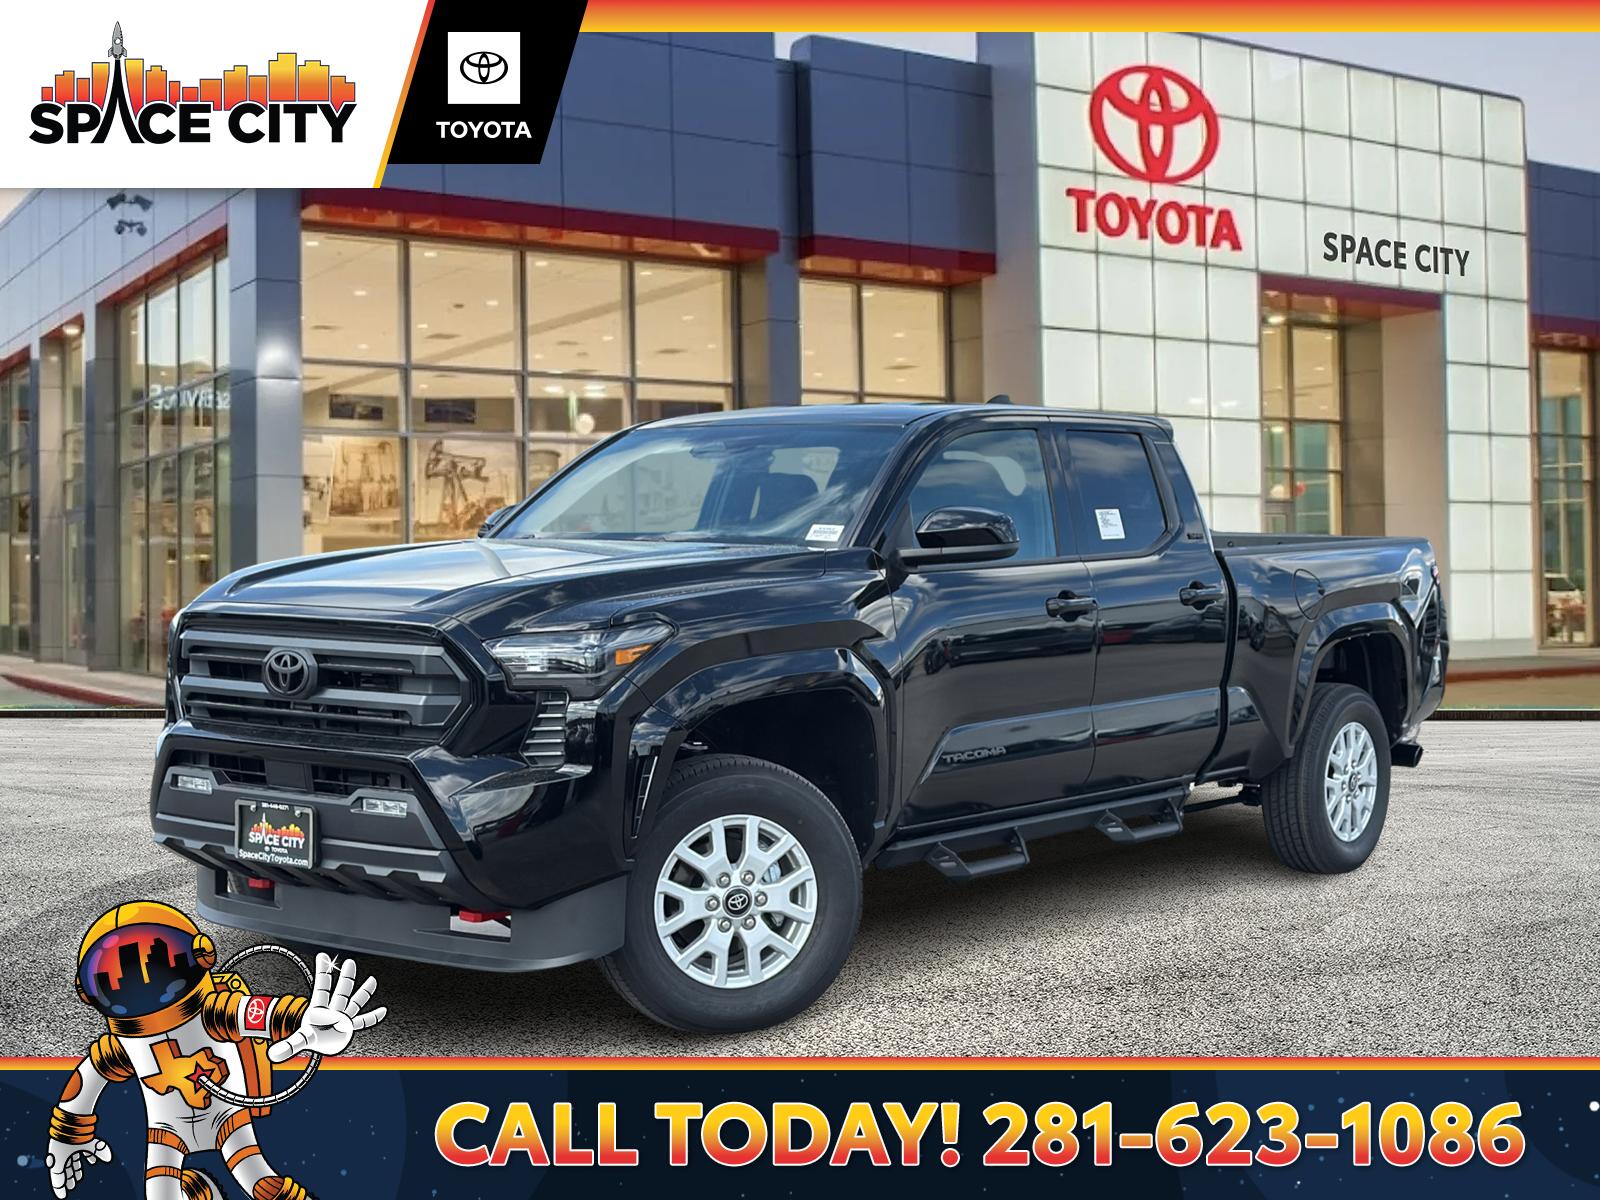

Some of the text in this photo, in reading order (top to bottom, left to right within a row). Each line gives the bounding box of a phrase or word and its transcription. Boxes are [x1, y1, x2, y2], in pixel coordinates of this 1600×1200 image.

[1066, 187, 1242, 251] TOYOTA
[1323, 231, 1470, 277] SPACE CITY
[942, 746, 1006, 763] TACOMA
[248, 828, 305, 849] SPACE CITY
